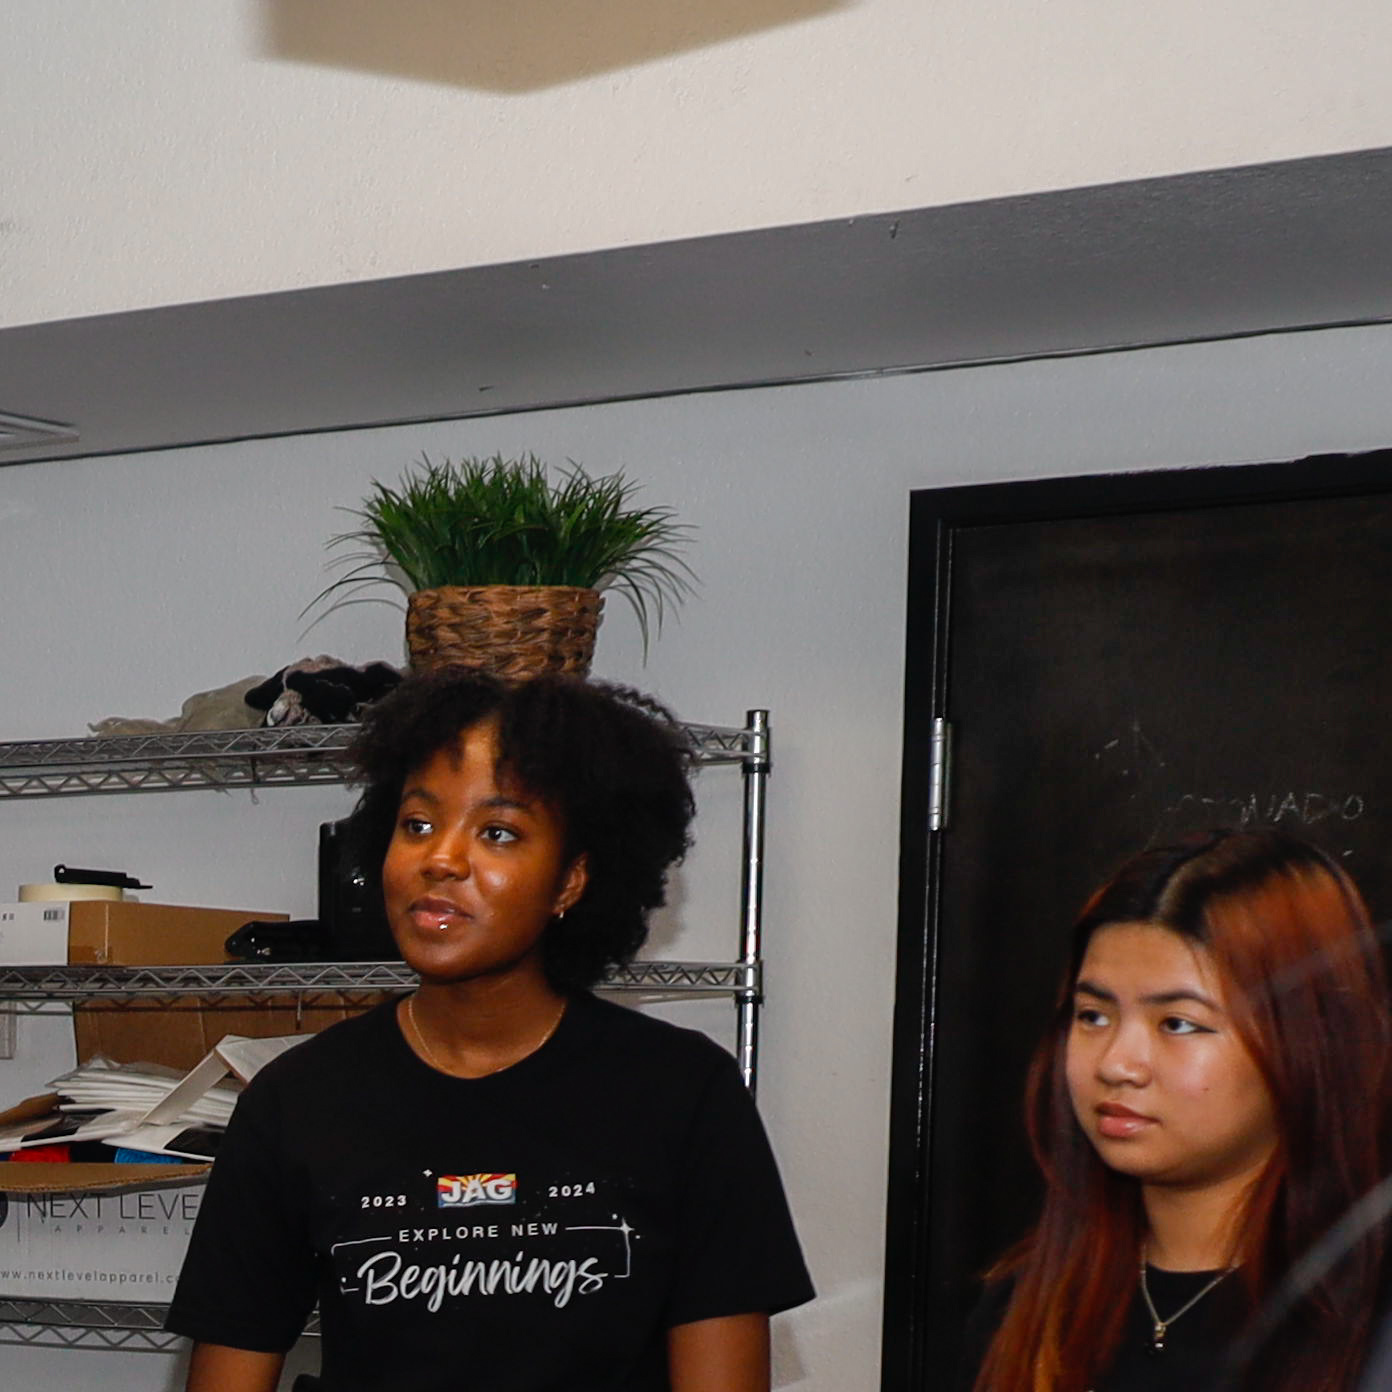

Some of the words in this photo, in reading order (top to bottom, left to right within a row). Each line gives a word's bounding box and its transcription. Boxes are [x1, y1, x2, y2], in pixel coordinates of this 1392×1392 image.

[27, 1193, 104, 1219] NEXT
[361, 1194, 407, 1209] 2023
[440, 1178, 514, 1205] JAG
[548, 1182, 596, 1198] 2024
[54, 1225, 190, 1236] APPAREL
[399, 1225, 499, 1242] EXPLORE
[512, 1222, 559, 1237] NEW
[357, 1251, 609, 1313] Beginnings
